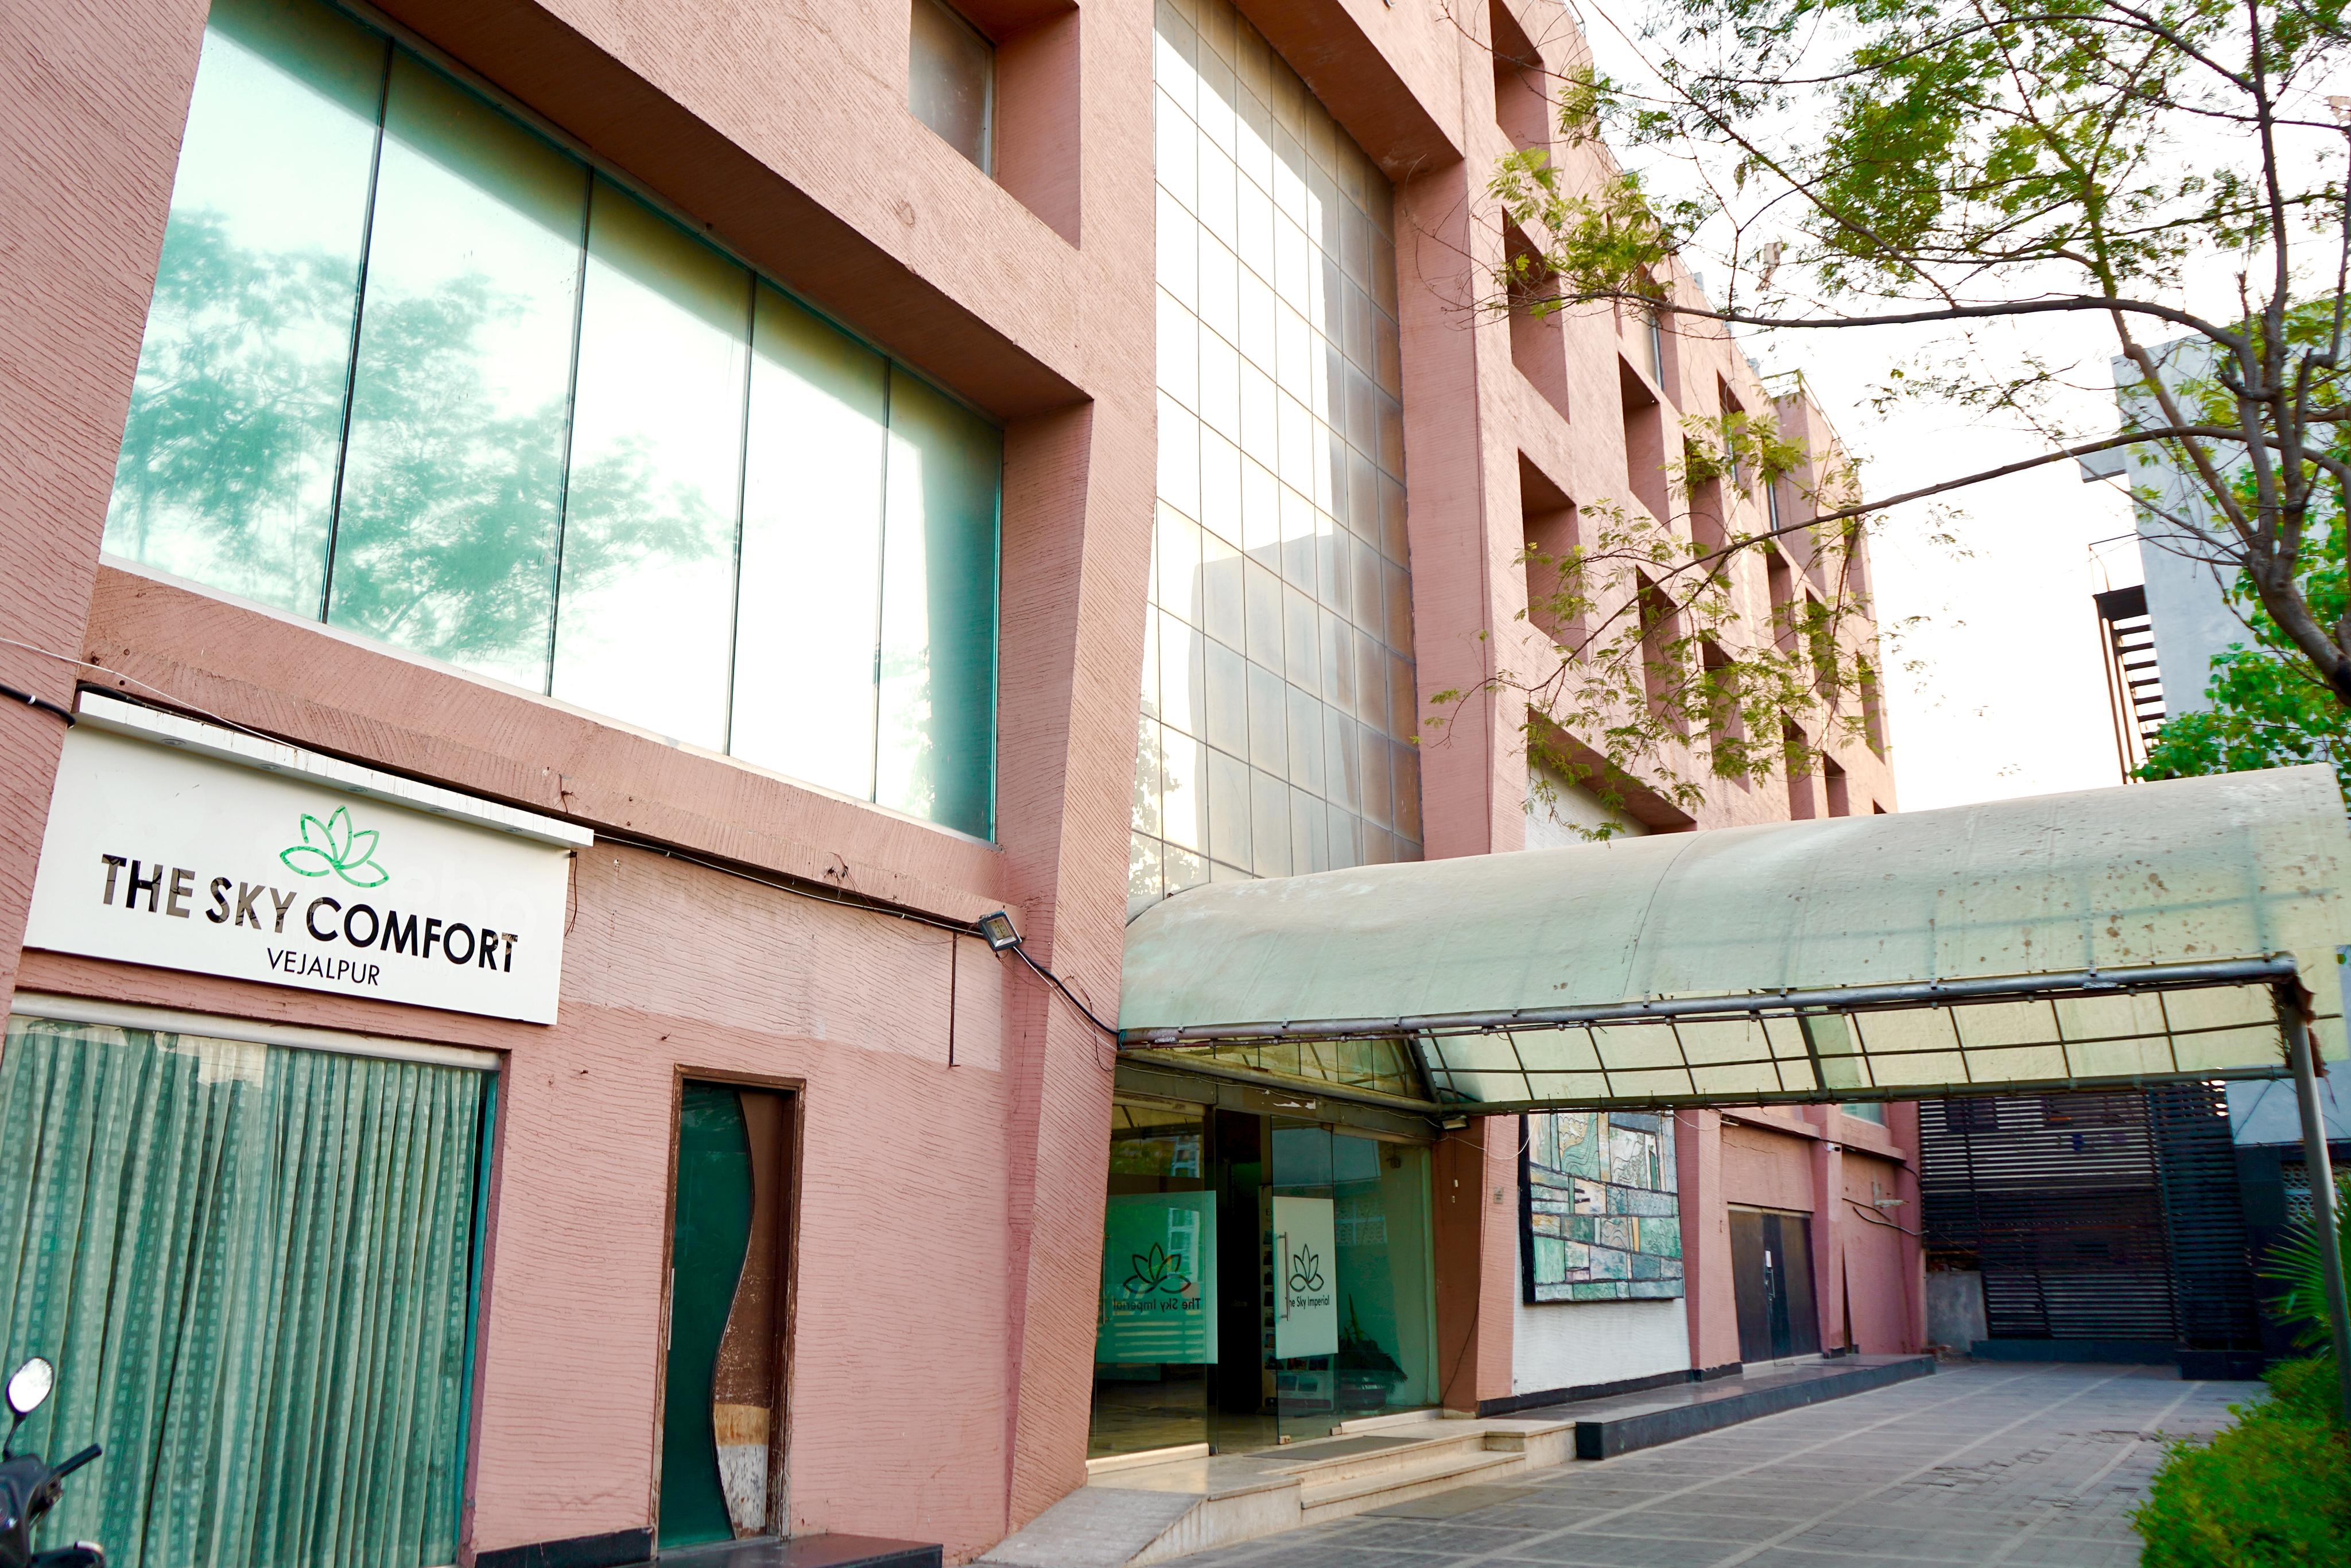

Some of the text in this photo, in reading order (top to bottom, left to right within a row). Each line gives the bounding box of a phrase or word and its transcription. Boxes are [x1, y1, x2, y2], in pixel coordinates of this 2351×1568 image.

[101, 853, 196, 919] THE
[205, 876, 297, 933] SKY
[306, 896, 518, 973] COMFORT
[267, 948, 380, 986] VEJALPUR
[1297, 1295, 1306, 1309] Sky
[1308, 1295, 1330, 1309] Imperial
